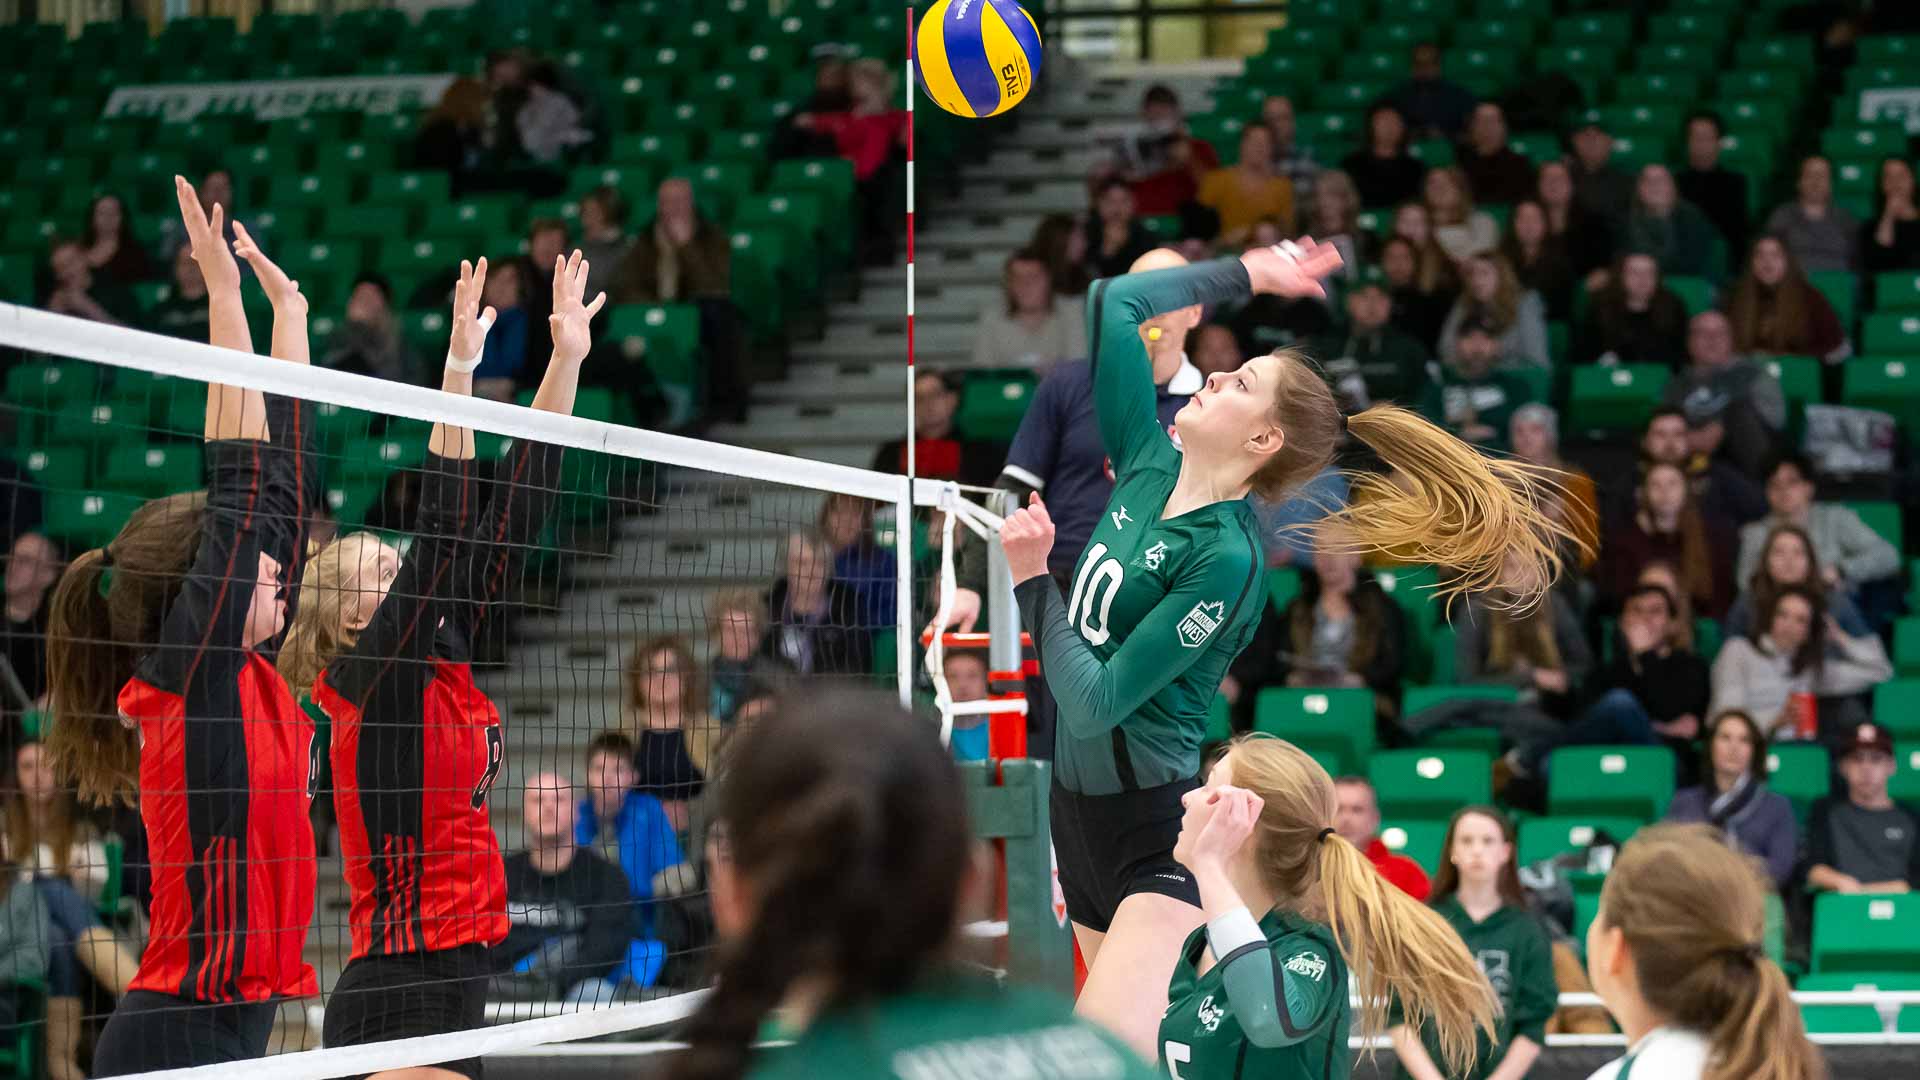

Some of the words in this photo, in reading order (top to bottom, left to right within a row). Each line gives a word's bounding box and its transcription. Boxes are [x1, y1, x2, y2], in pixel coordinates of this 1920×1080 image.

[1001, 63, 1019, 98] FIVB
[1067, 542, 1124, 646] 10
[1181, 618, 1207, 644] WEST
